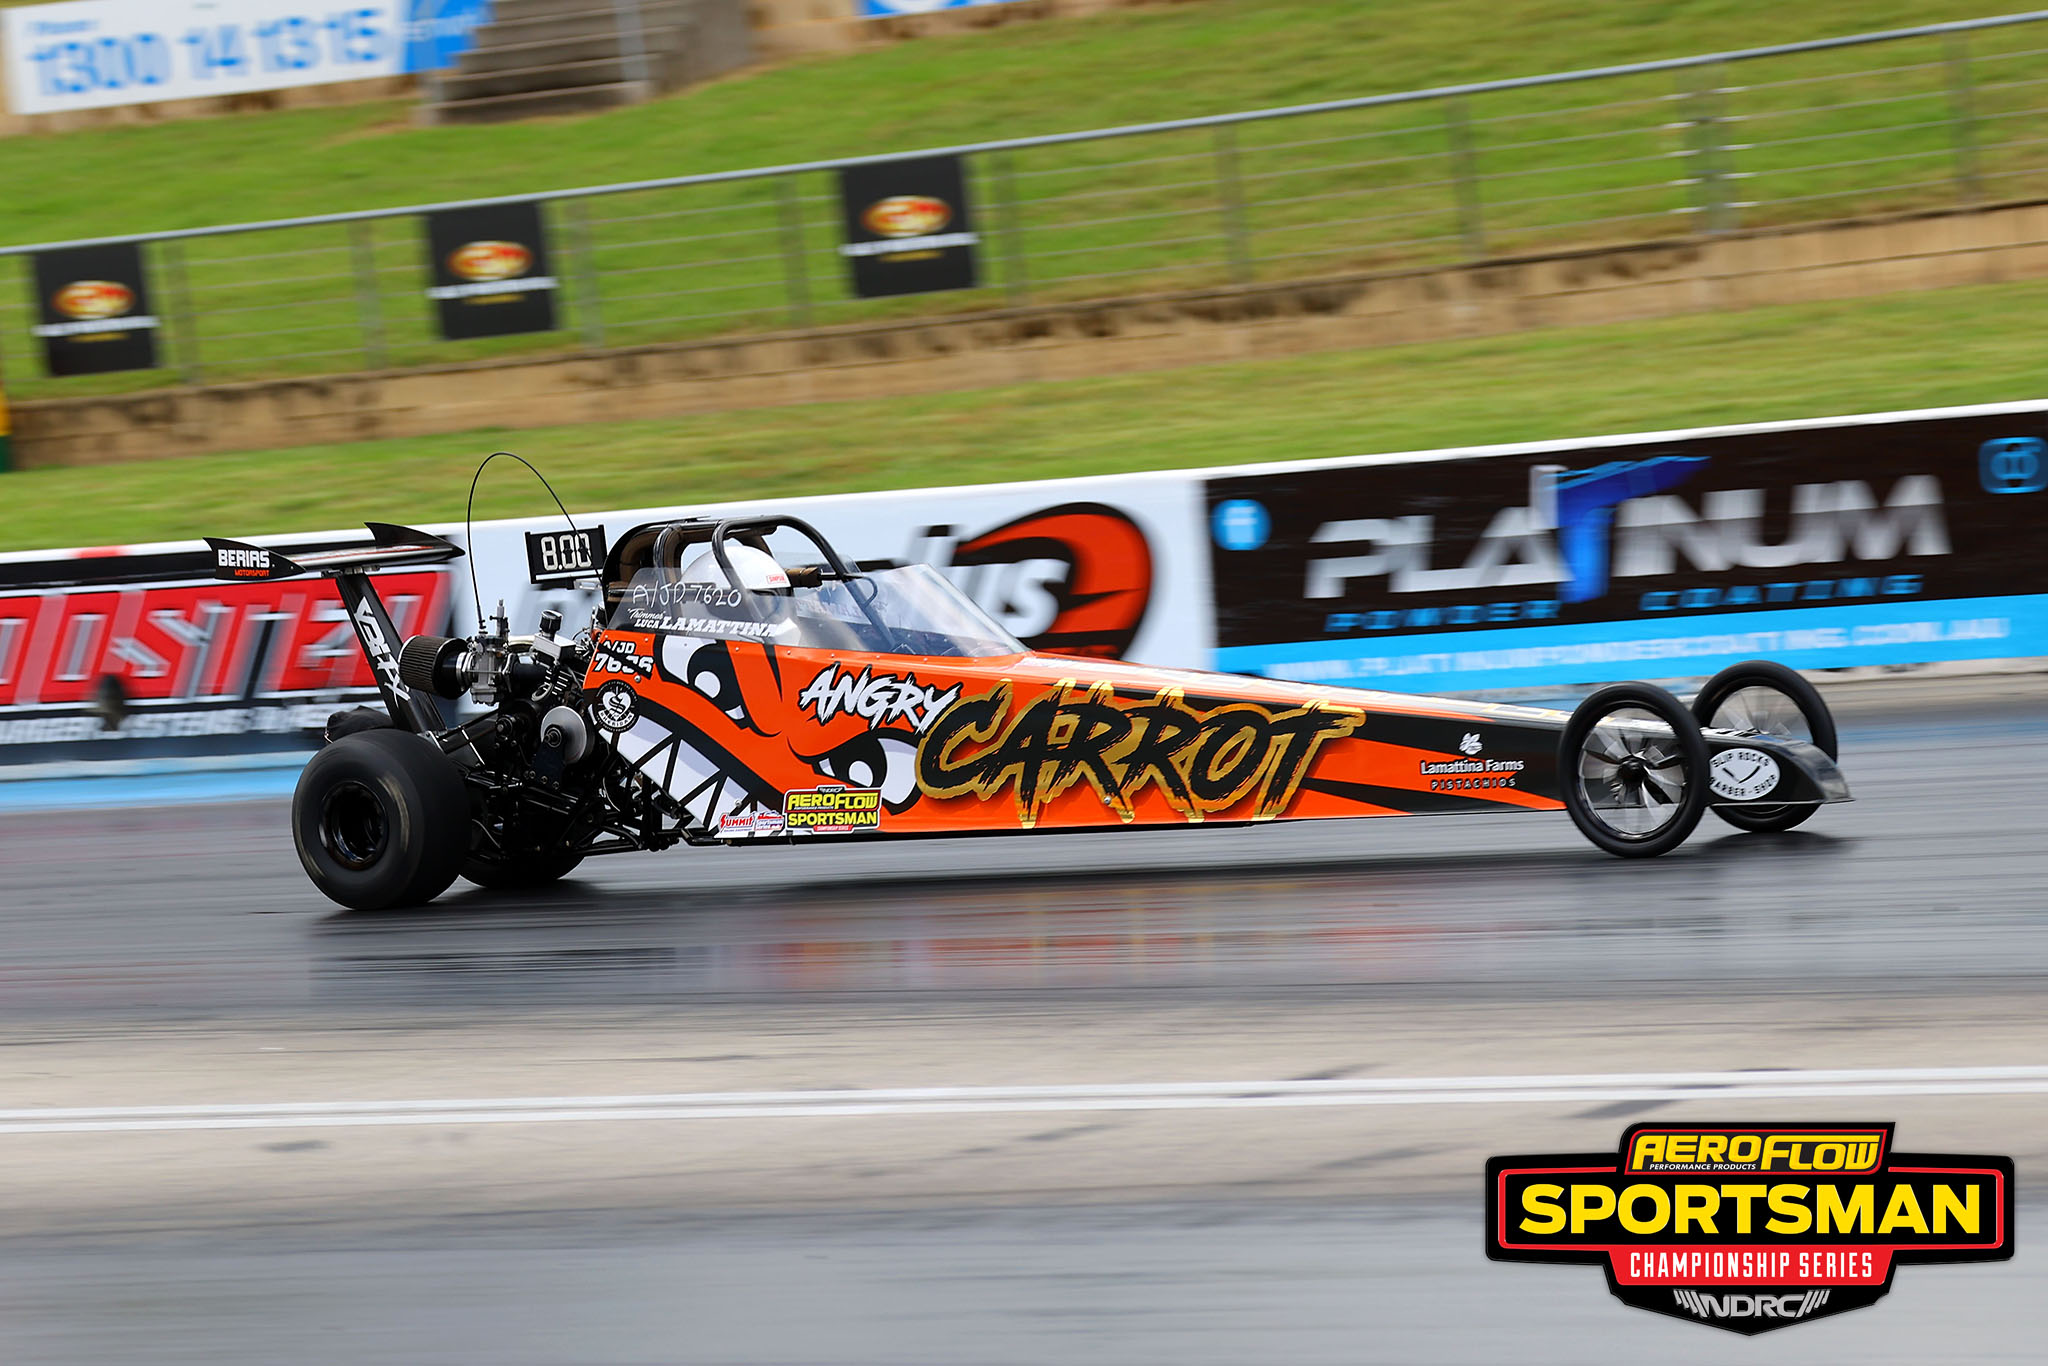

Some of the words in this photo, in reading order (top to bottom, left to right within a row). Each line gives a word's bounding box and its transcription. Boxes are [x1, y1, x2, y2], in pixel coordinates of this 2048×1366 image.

[1303, 457, 1954, 602] PLATINUM
[217, 548, 270, 568] BERIAS
[541, 533, 592, 571] 8.00
[690, 584, 741, 608] 7620
[1324, 600, 1562, 633] POWDER
[1638, 574, 1926, 612] COATING
[634, 618, 660, 629] LUCA
[659, 616, 780, 638] LAMATTINA
[800, 662, 962, 735] ANGRY
[916, 678, 1367, 828] CARROT
[1421, 760, 1484, 774] Lamattina
[1485, 760, 1525, 772] Farms
[1431, 778, 1516, 790] PISTACHIOS
[787, 792, 879, 811] AEROFLOW
[788, 811, 877, 826] SPORTSMAN
